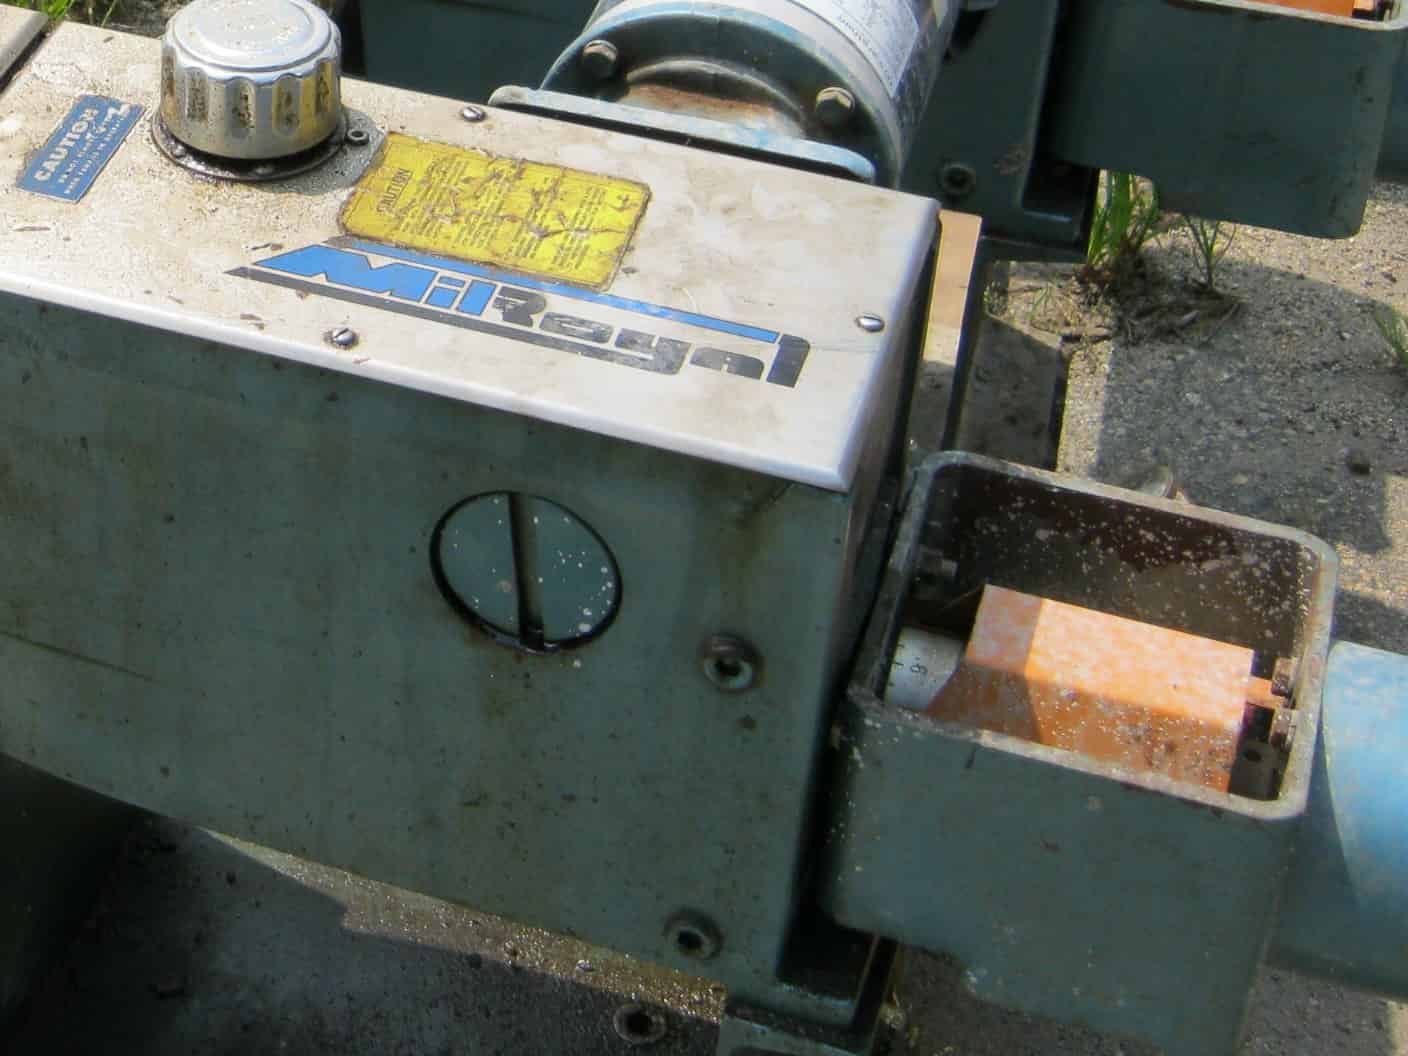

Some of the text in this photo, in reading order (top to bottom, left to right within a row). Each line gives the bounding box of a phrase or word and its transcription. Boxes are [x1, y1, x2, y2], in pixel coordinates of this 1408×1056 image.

[33, 106, 101, 184] CAUTION
[375, 167, 414, 215] CAUTION
[234, 242, 813, 389] MilRoyal
